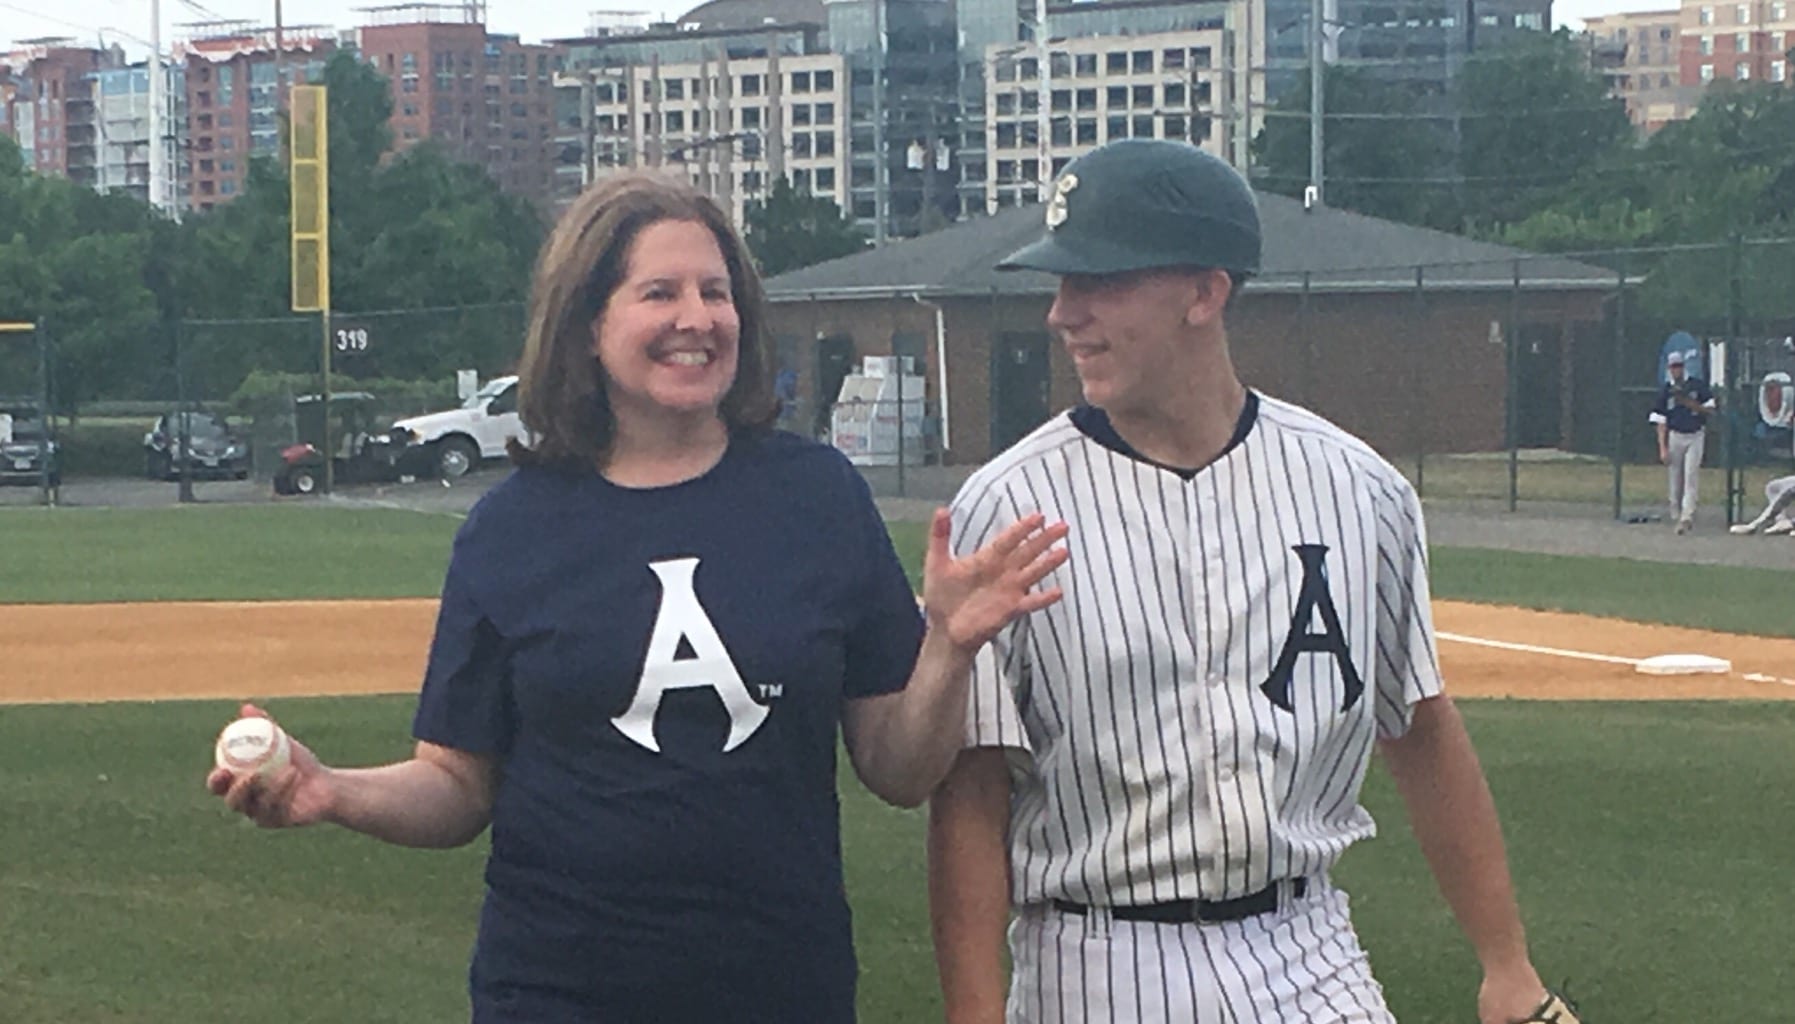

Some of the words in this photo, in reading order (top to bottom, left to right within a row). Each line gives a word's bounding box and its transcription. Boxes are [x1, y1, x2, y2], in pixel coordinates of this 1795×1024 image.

[336, 329, 367, 350] 319
[610, 556, 770, 753] A
[758, 684, 783, 698] TM
[1259, 544, 1365, 714] A
